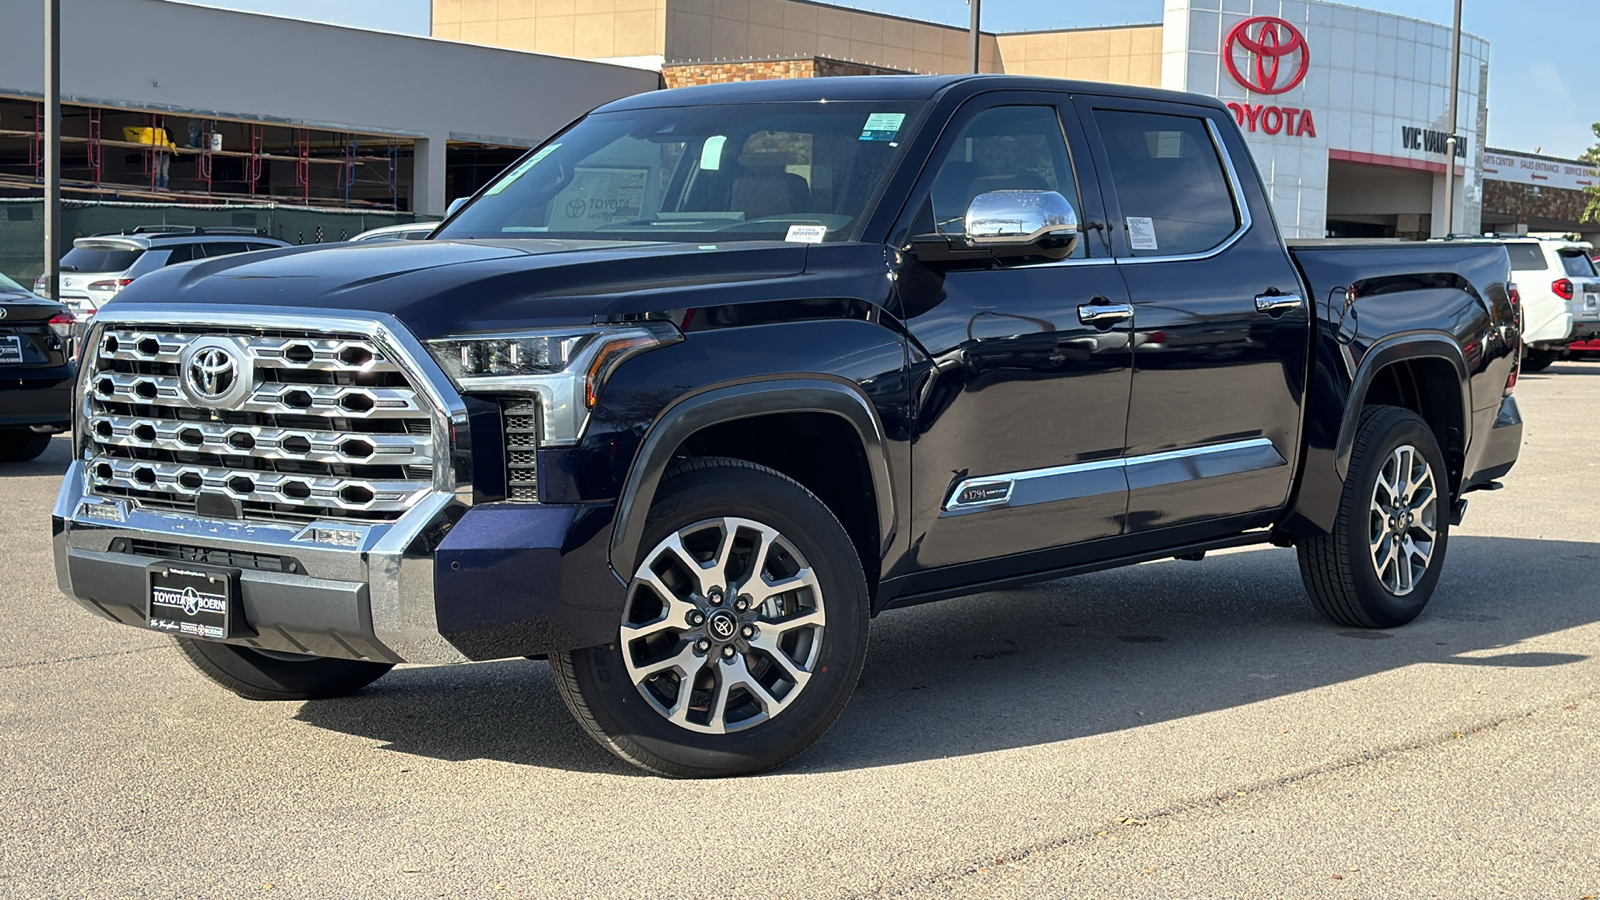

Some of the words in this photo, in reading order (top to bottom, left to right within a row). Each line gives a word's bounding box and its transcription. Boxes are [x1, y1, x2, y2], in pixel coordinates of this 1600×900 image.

[1226, 102, 1316, 138] OYOTA
[1402, 126, 1421, 150] VIC
[1423, 129, 1467, 158] VAUGAN
[1483, 155, 1495, 165] ARTS
[1496, 157, 1514, 167] CENTER
[1520, 159, 1534, 170] SALES
[1535, 162, 1559, 173] ENTRANCE
[1564, 166, 1581, 176] SERVICE
[589, 198, 629, 209] TOYOTA
[969, 489, 987, 499] 1794
[153, 592, 186, 605] TOYOTA
